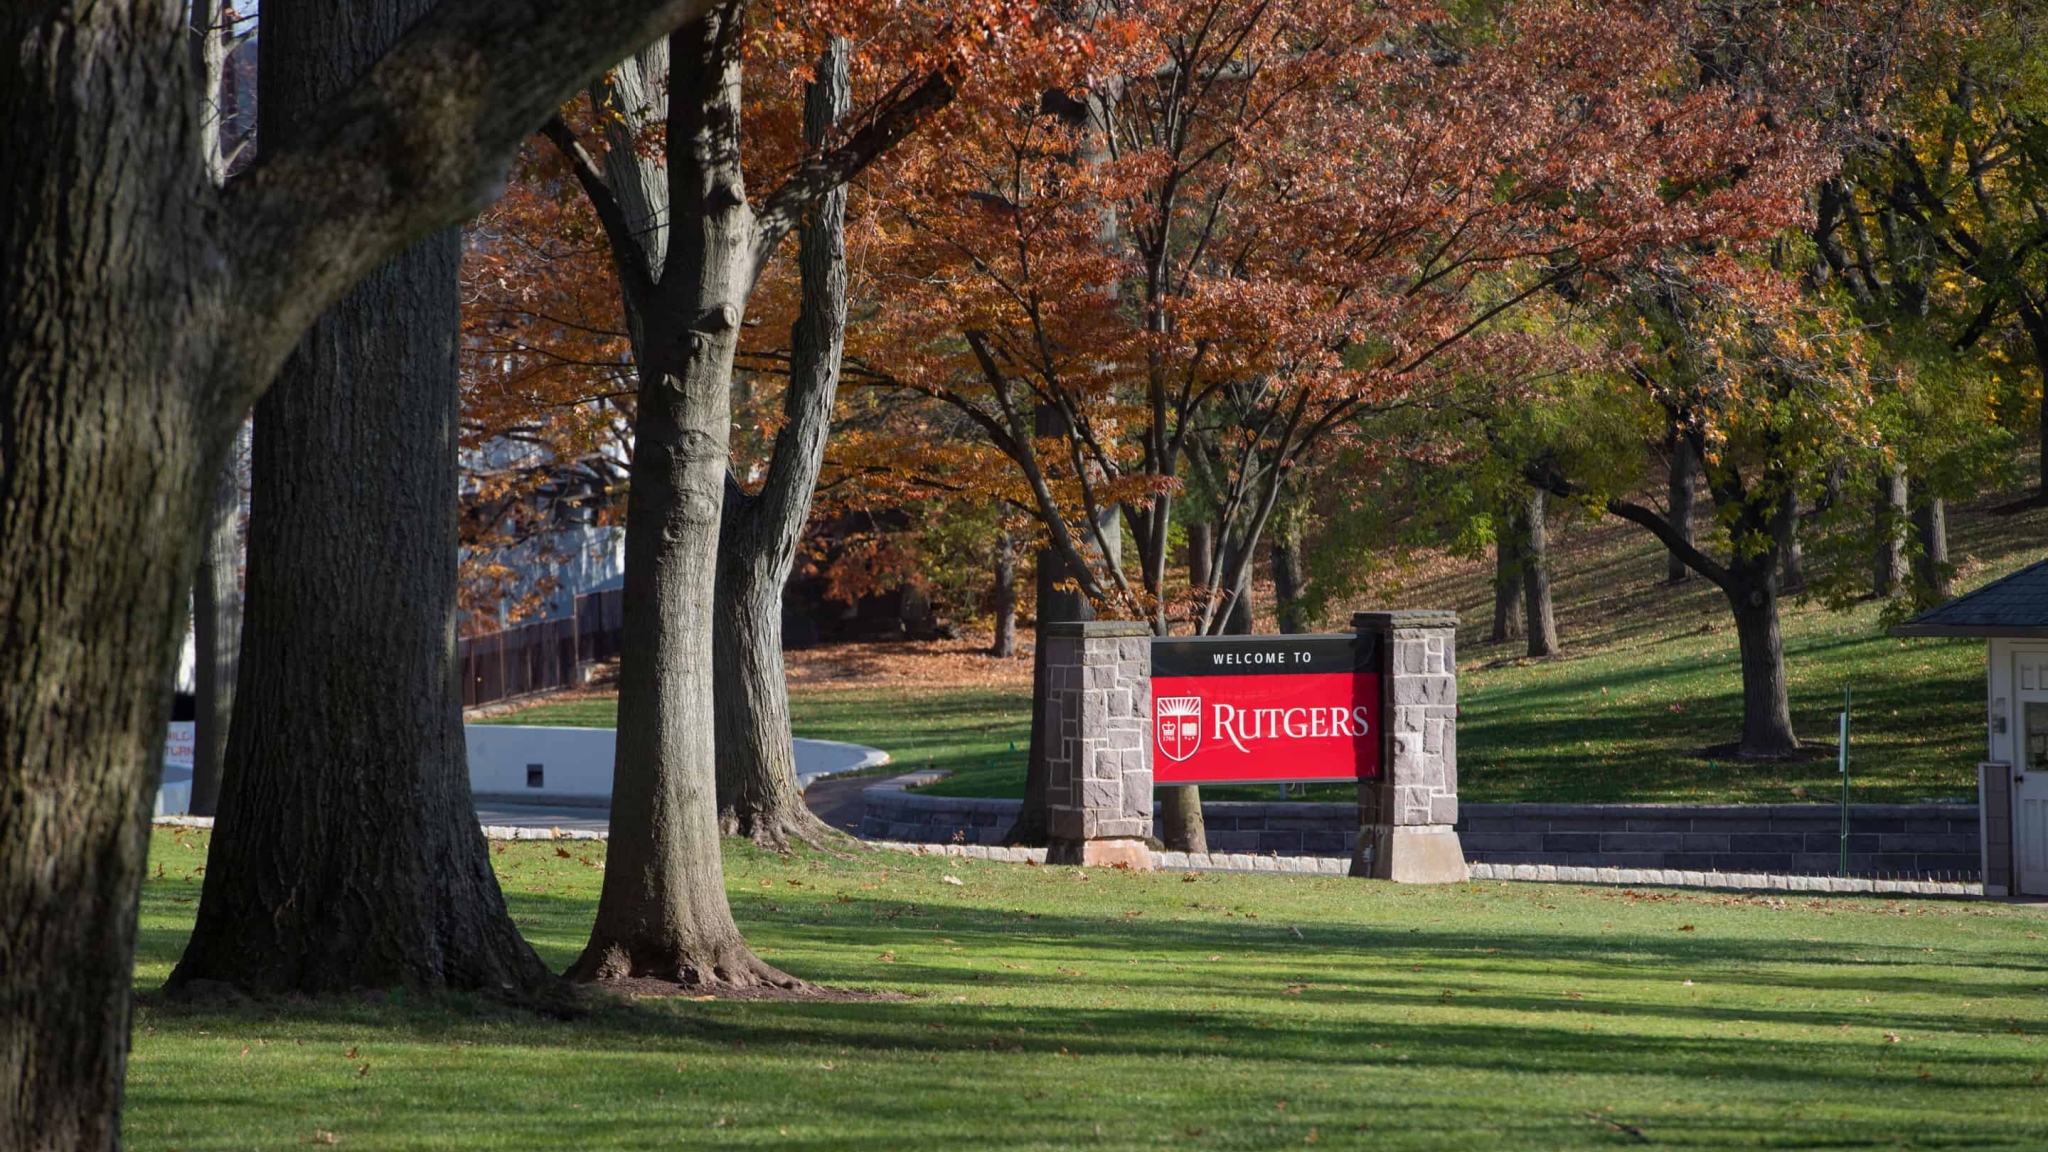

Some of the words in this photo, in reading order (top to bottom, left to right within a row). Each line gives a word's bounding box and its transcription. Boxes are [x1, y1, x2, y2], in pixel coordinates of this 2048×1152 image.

[1213, 652, 1285, 665] WELCOME
[1293, 651, 1312, 663] TO
[1212, 703, 1369, 753] RUTGERS
